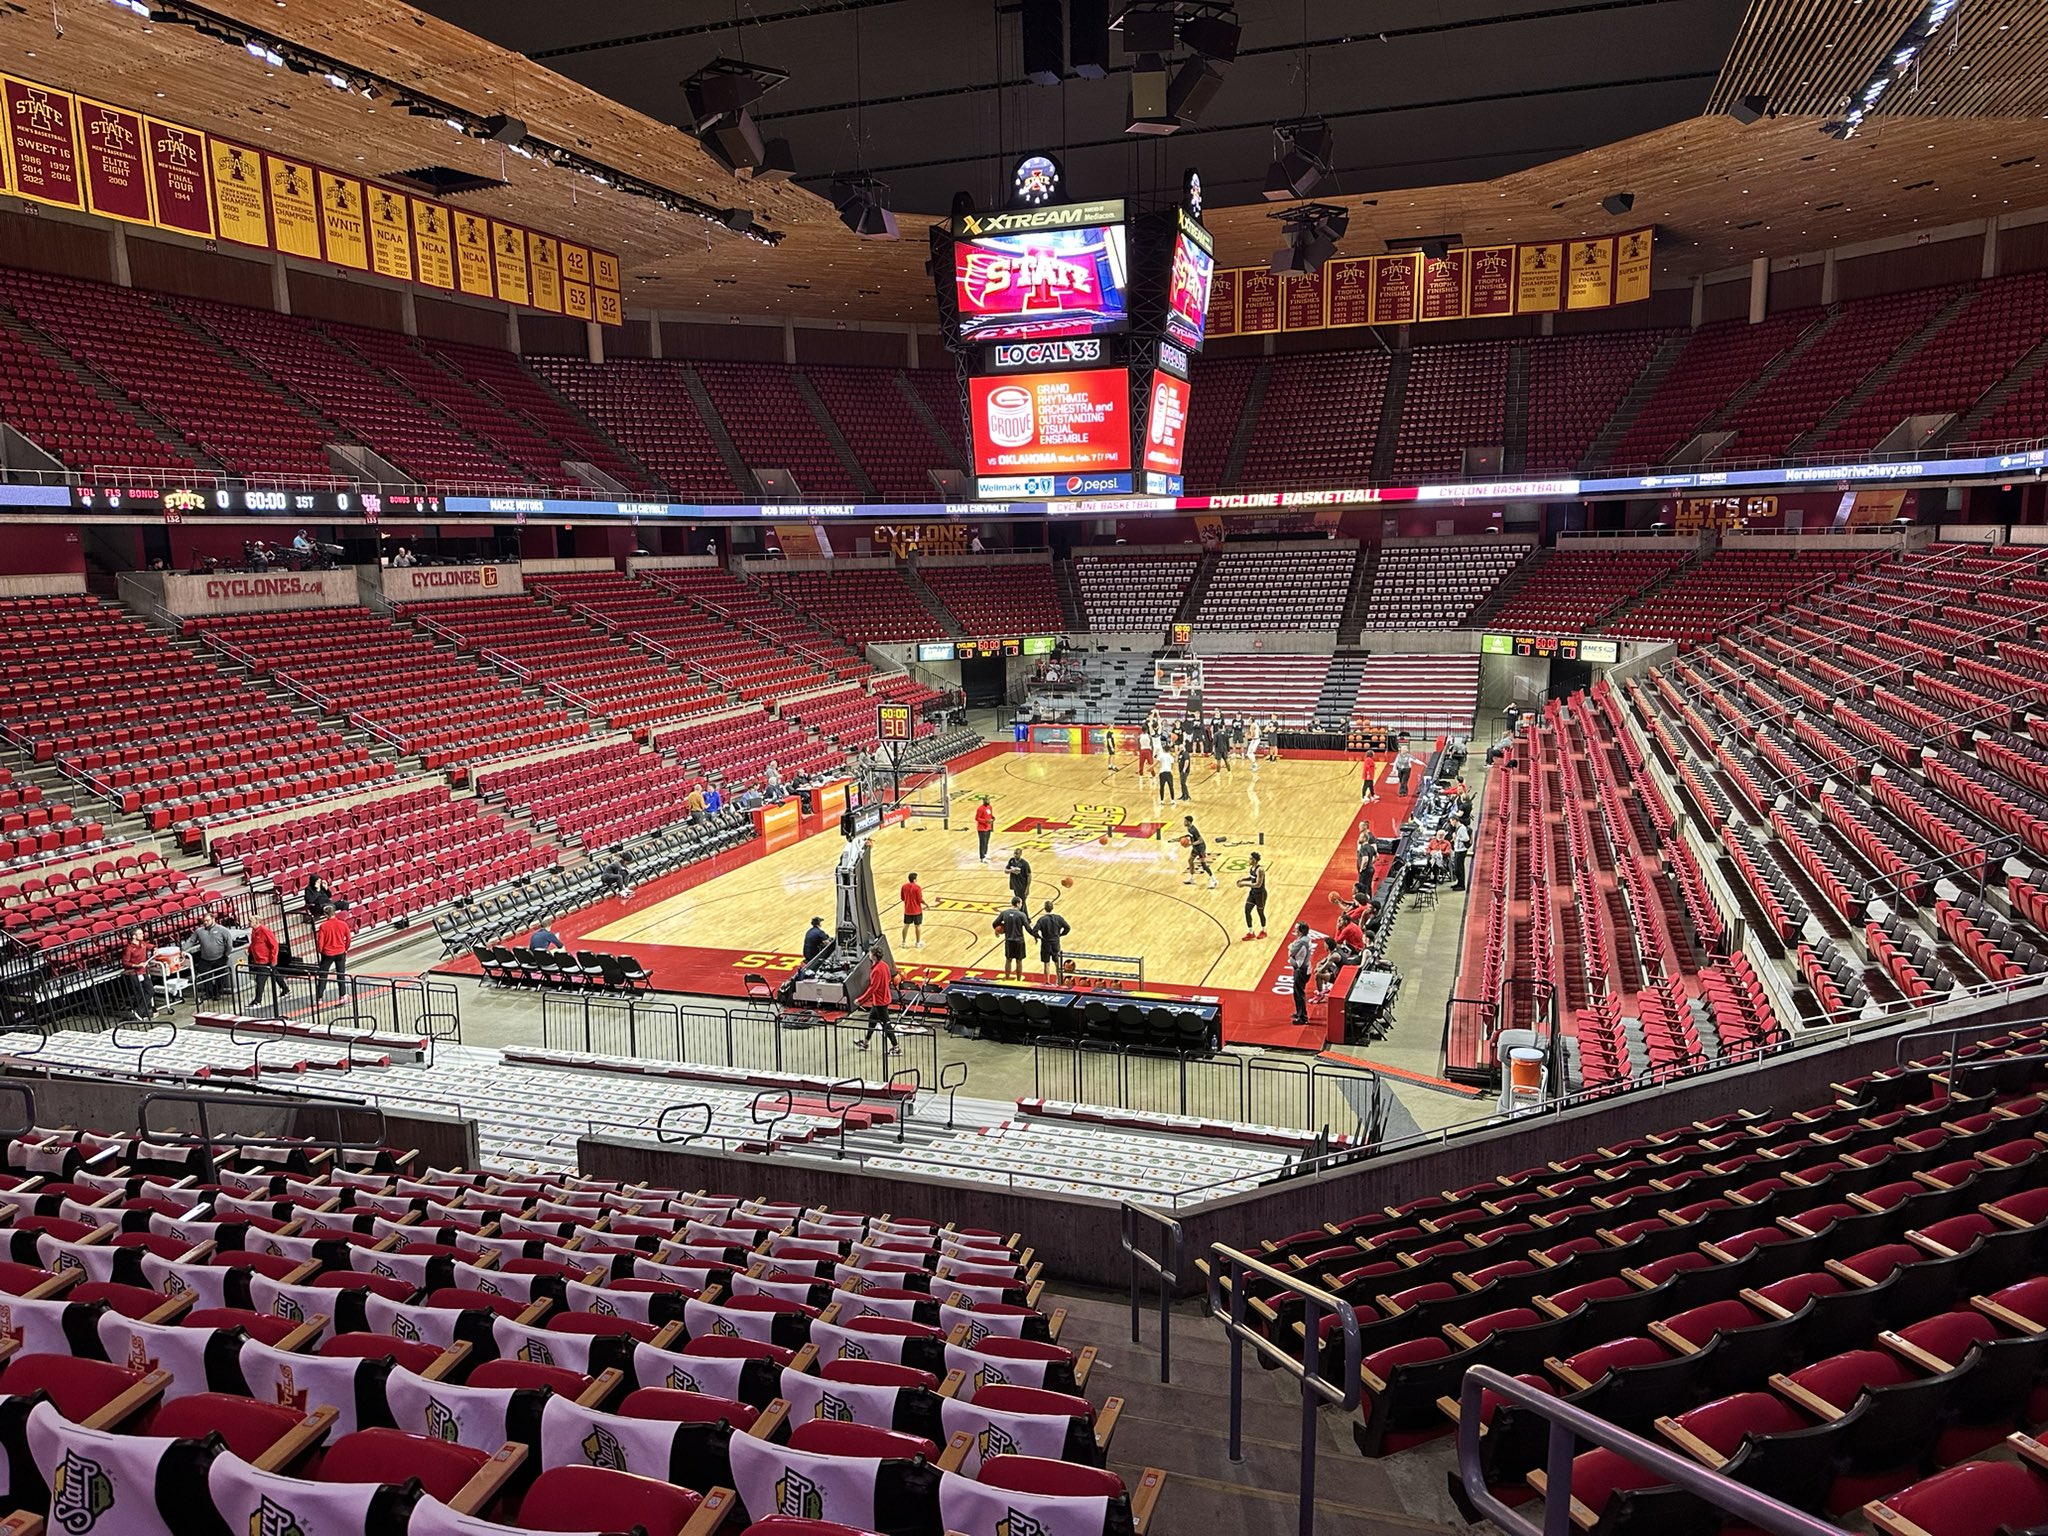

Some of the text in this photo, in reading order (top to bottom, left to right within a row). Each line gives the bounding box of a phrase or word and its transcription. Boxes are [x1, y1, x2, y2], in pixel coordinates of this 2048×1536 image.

[16, 100, 64, 126] STATE
[91, 121, 134, 145] STATE
[17, 138, 71, 158] SWEET 16
[157, 139, 197, 162] STATE
[20, 154, 70, 172] 1986 1997
[102, 156, 129, 169] ELITE
[219, 156, 256, 180] STATE
[22, 164, 71, 182] 2014 2016
[103, 164, 130, 177] EIGHT
[23, 174, 44, 185] 2022
[108, 176, 128, 186] 2000
[168, 173, 192, 184] FINAL
[169, 180, 194, 193] FOUR
[175, 192, 190, 201] 1944
[220, 195, 261, 209] CHAMPIONS
[275, 201, 313, 215] CONFERENCE
[276, 208, 315, 223] CHAMPIONS
[984, 208, 1083, 231] XTREAM
[328, 216, 360, 233] WNIT
[377, 229, 403, 244] NCAA
[422, 241, 446, 255] NCAA
[463, 252, 485, 264] NCAA
[568, 252, 583, 269] 42
[1477, 258, 1507, 269] STATE
[600, 261, 611, 276] 51
[1381, 266, 1411, 277] STATE
[1428, 261, 1458, 273] STATE
[1619, 267, 1638, 275] SUPER
[984, 255, 1091, 295] STATE
[1336, 269, 1365, 280] STATE
[1247, 277, 1275, 288] STATE
[571, 289, 586, 305] 53
[602, 296, 616, 312] 32
[996, 339, 1100, 366] LOCAL 33
[1036, 383, 1069, 393] GRAND
[1037, 393, 1088, 404] RHYTHMIC
[1038, 402, 1113, 414] ORCHESTRA and
[1039, 413, 1105, 424] OUTSTANDING
[991, 414, 1032, 438] GROOVE
[1039, 424, 1073, 434] VISUAL
[1040, 433, 1088, 444] ENSEMBLE
[998, 452, 1057, 465] OKLAHOMA
[1786, 464, 1923, 481] MoreIowansDriveChevy.com
[980, 482, 1021, 492] Wellmark
[1084, 478, 1118, 491] pepsi
[1440, 484, 1564, 496] CYCLONE BASKETBALL
[105, 488, 121, 497] FLS
[129, 489, 159, 498] BONUS
[216, 490, 230, 508] 0
[1209, 489, 1382, 508] CYCLONE BASKETBALL
[164, 492, 205, 510] STATE
[245, 492, 314, 510] 60:00 1ST
[337, 494, 348, 510] 0
[390, 496, 410, 504] BONUS
[516, 500, 544, 511] MOTORS
[1057, 501, 1159, 512] CYCLONE BASKETBALL
[638, 504, 669, 514] CHEVROLET
[761, 506, 854, 514] BOB BROWN CHEVROLET
[970, 504, 1010, 513] CHEVROLET
[1676, 496, 1778, 519] LET'S GO
[166, 515, 180, 523] 132
[874, 524, 967, 543] CYCLONE
[891, 541, 967, 559] NATION
[412, 570, 480, 588] CYCLONES
[207, 577, 325, 599] CYCLONES.com
[1177, 632, 1188, 641] 30
[881, 708, 907, 719] 60:00
[886, 720, 905, 736] 30
[54, 1451, 98, 1532] Starry
